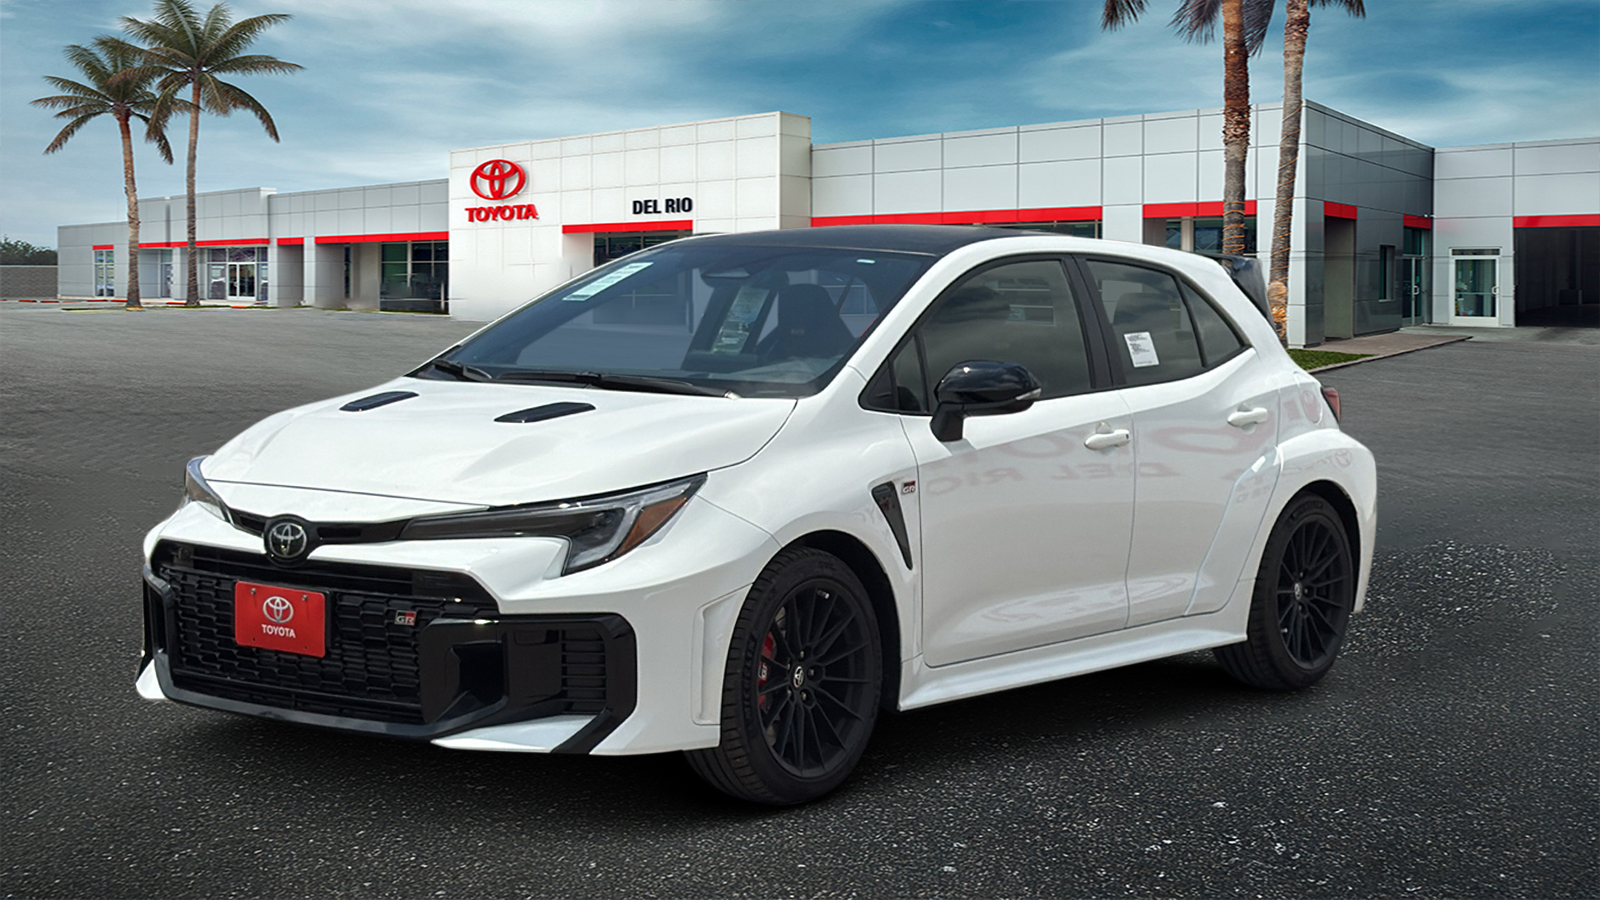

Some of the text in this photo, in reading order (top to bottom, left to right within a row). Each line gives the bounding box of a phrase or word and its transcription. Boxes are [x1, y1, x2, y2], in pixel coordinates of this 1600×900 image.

[465, 203, 539, 223] TOYOTA
[632, 197, 693, 215] DEL RIO
[902, 484, 916, 495] GR
[395, 613, 416, 626] GR
[261, 624, 296, 638] TOYOTA
